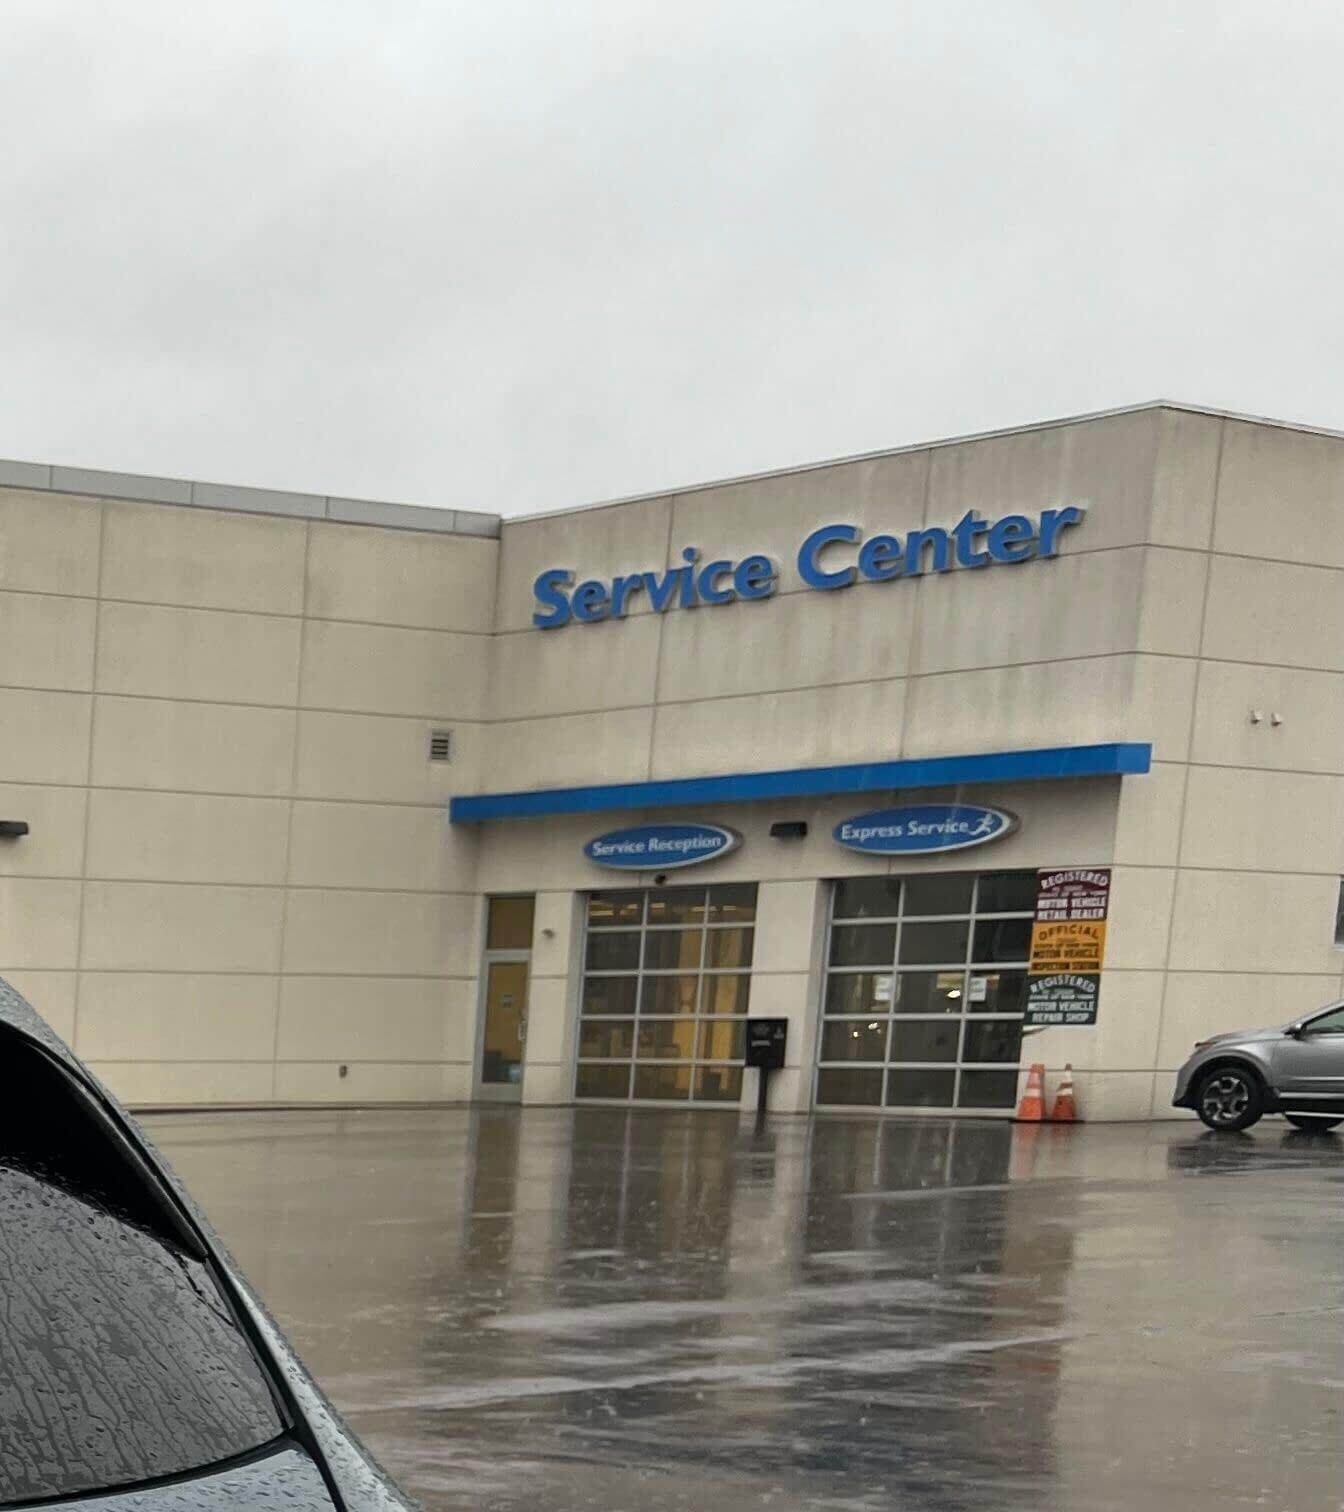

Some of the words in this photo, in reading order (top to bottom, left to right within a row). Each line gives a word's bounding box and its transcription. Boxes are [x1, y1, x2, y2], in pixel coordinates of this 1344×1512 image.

[532, 546, 779, 630] Service
[796, 505, 1088, 590] Center
[841, 823, 903, 843] Express
[907, 818, 969, 836] Service
[592, 839, 645, 857] Service
[648, 833, 722, 853] Reception
[1040, 870, 1108, 890] REGISTERED
[1038, 924, 1099, 941] OFFICIAL
[1030, 975, 1095, 993] REGISTERED
